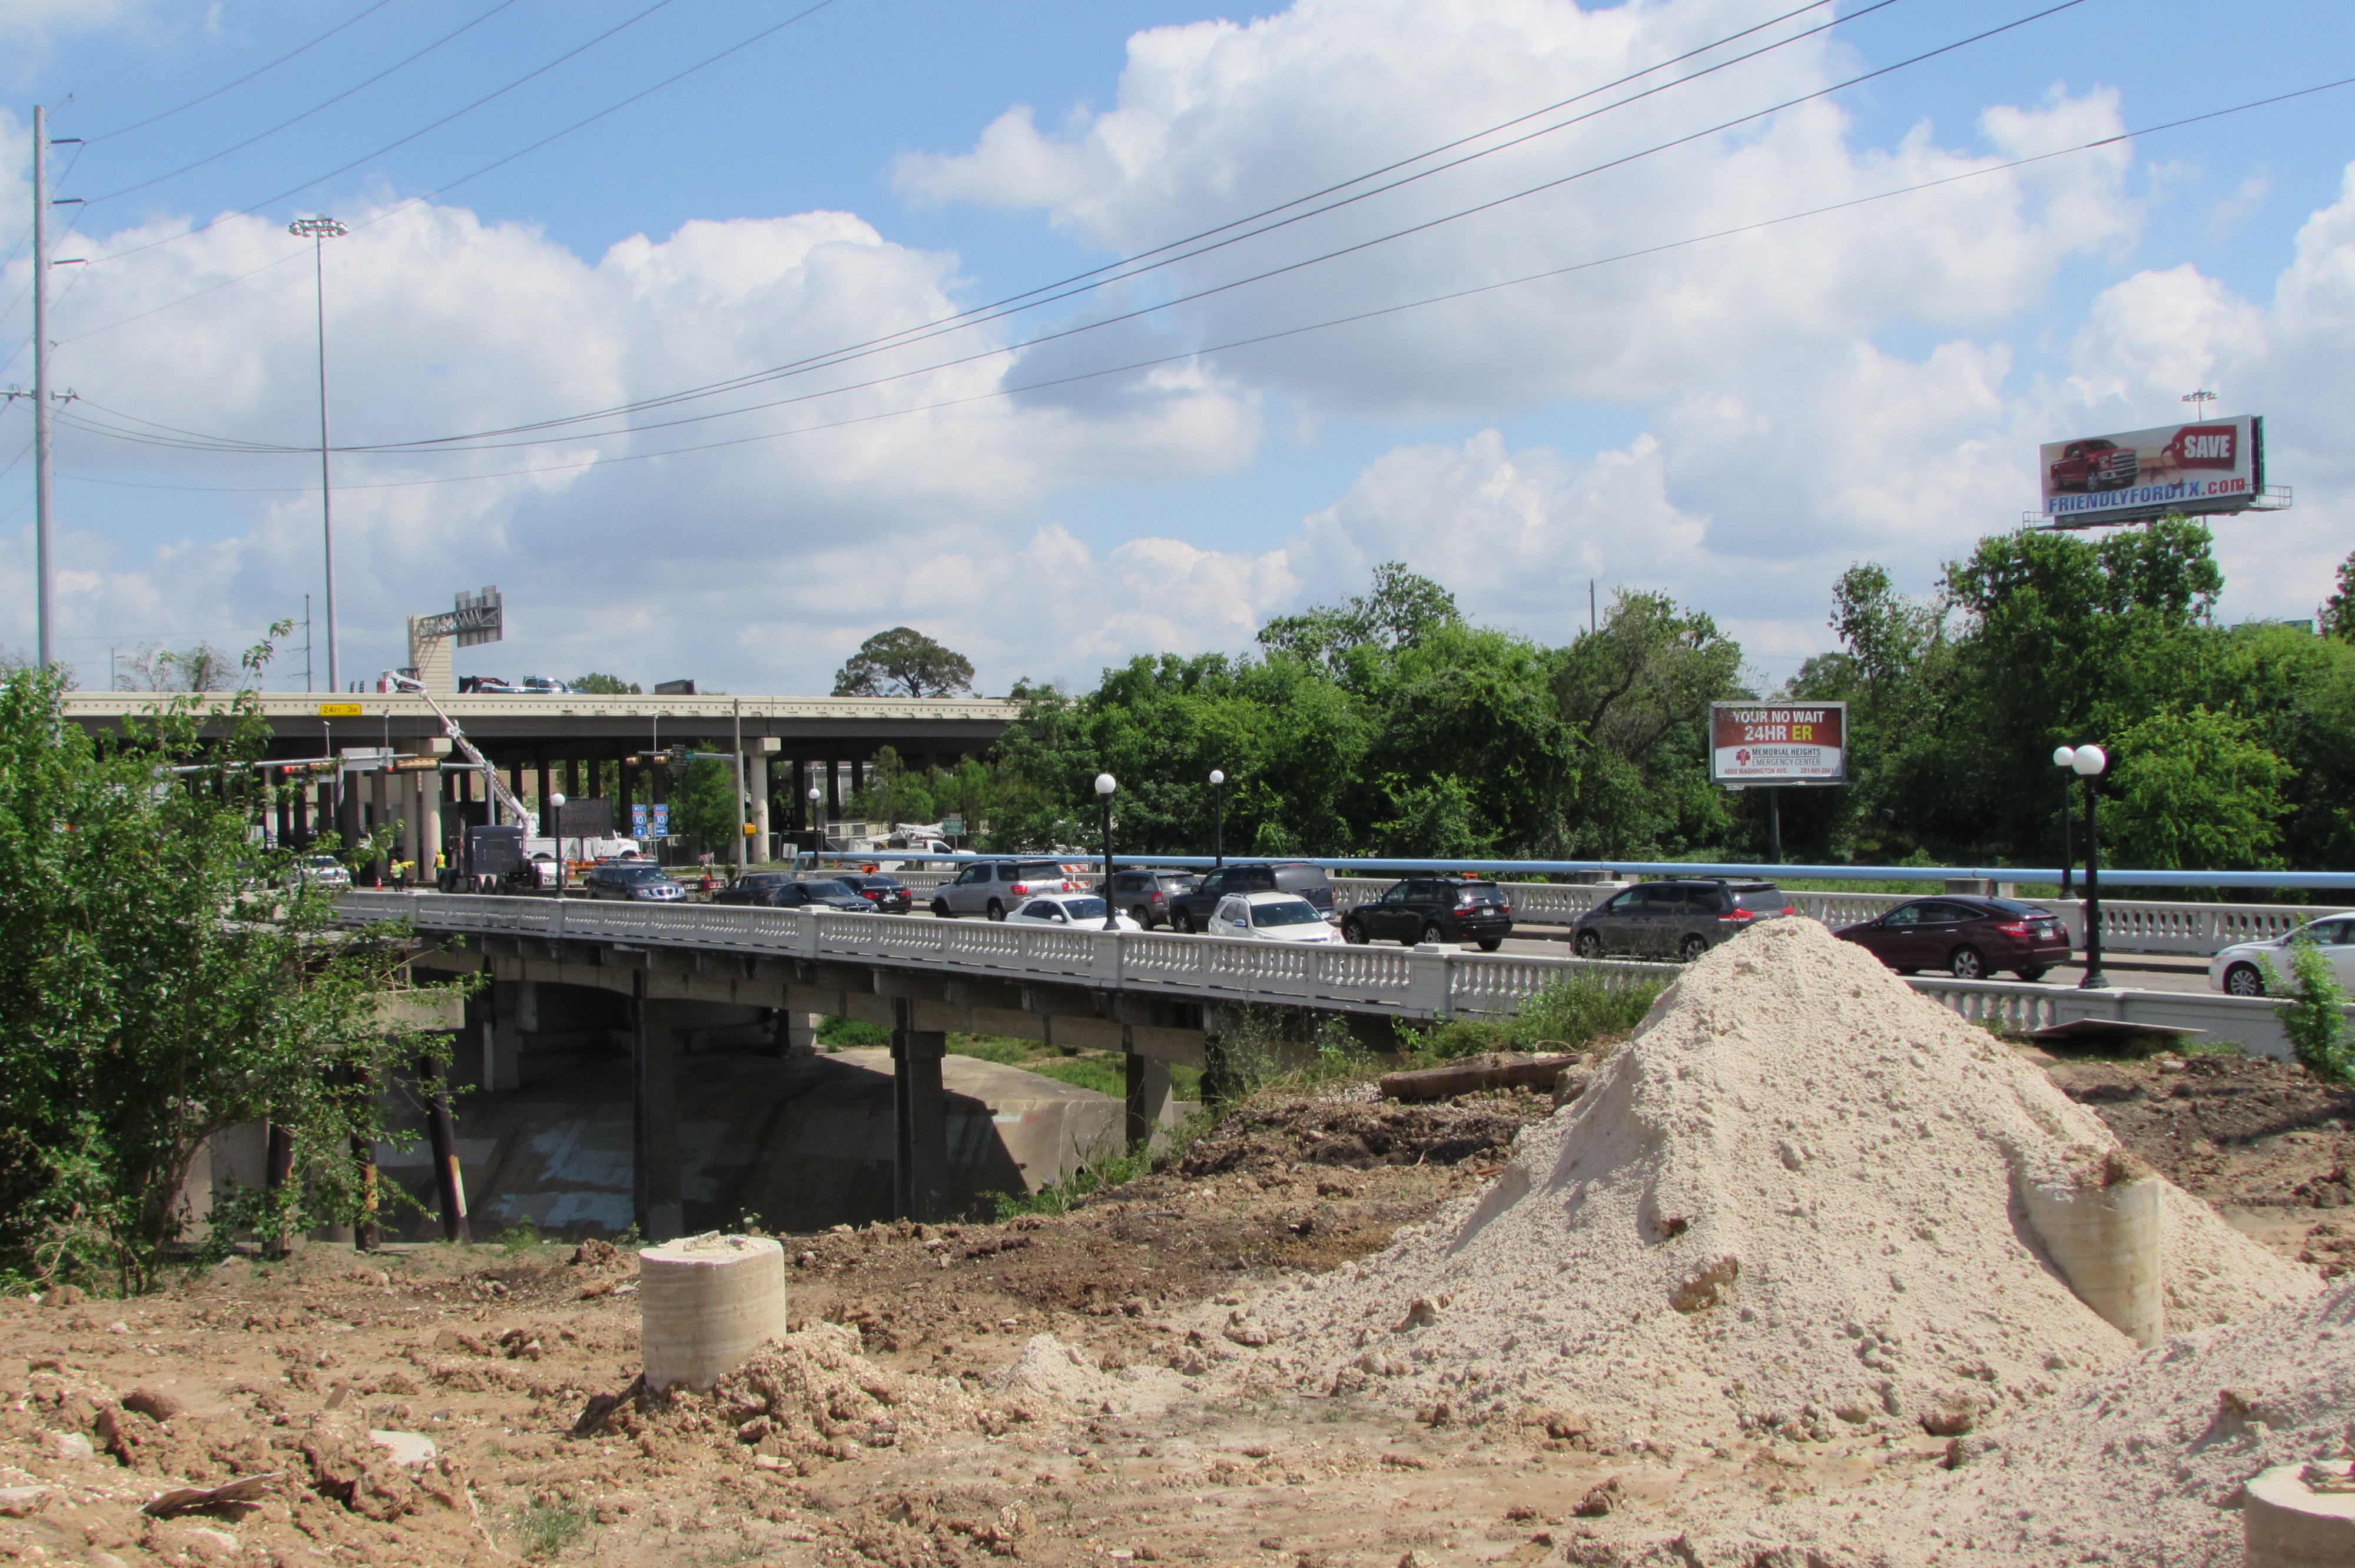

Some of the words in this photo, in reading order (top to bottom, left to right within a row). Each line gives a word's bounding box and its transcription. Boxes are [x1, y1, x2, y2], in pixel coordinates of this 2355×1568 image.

[2184, 435, 2230, 458] SAVE
[2048, 477, 2245, 513] FRIENDLYFORDTX.com
[1732, 710, 1768, 723] YOUR
[1772, 710, 1790, 723] NO
[1793, 710, 1825, 723] WAIT
[1744, 725, 1787, 741] 24HR
[1792, 725, 1813, 740] ER
[560, 812, 602, 824] BRIDGE
[635, 815, 644, 825] 10
[657, 815, 665, 824] 10
